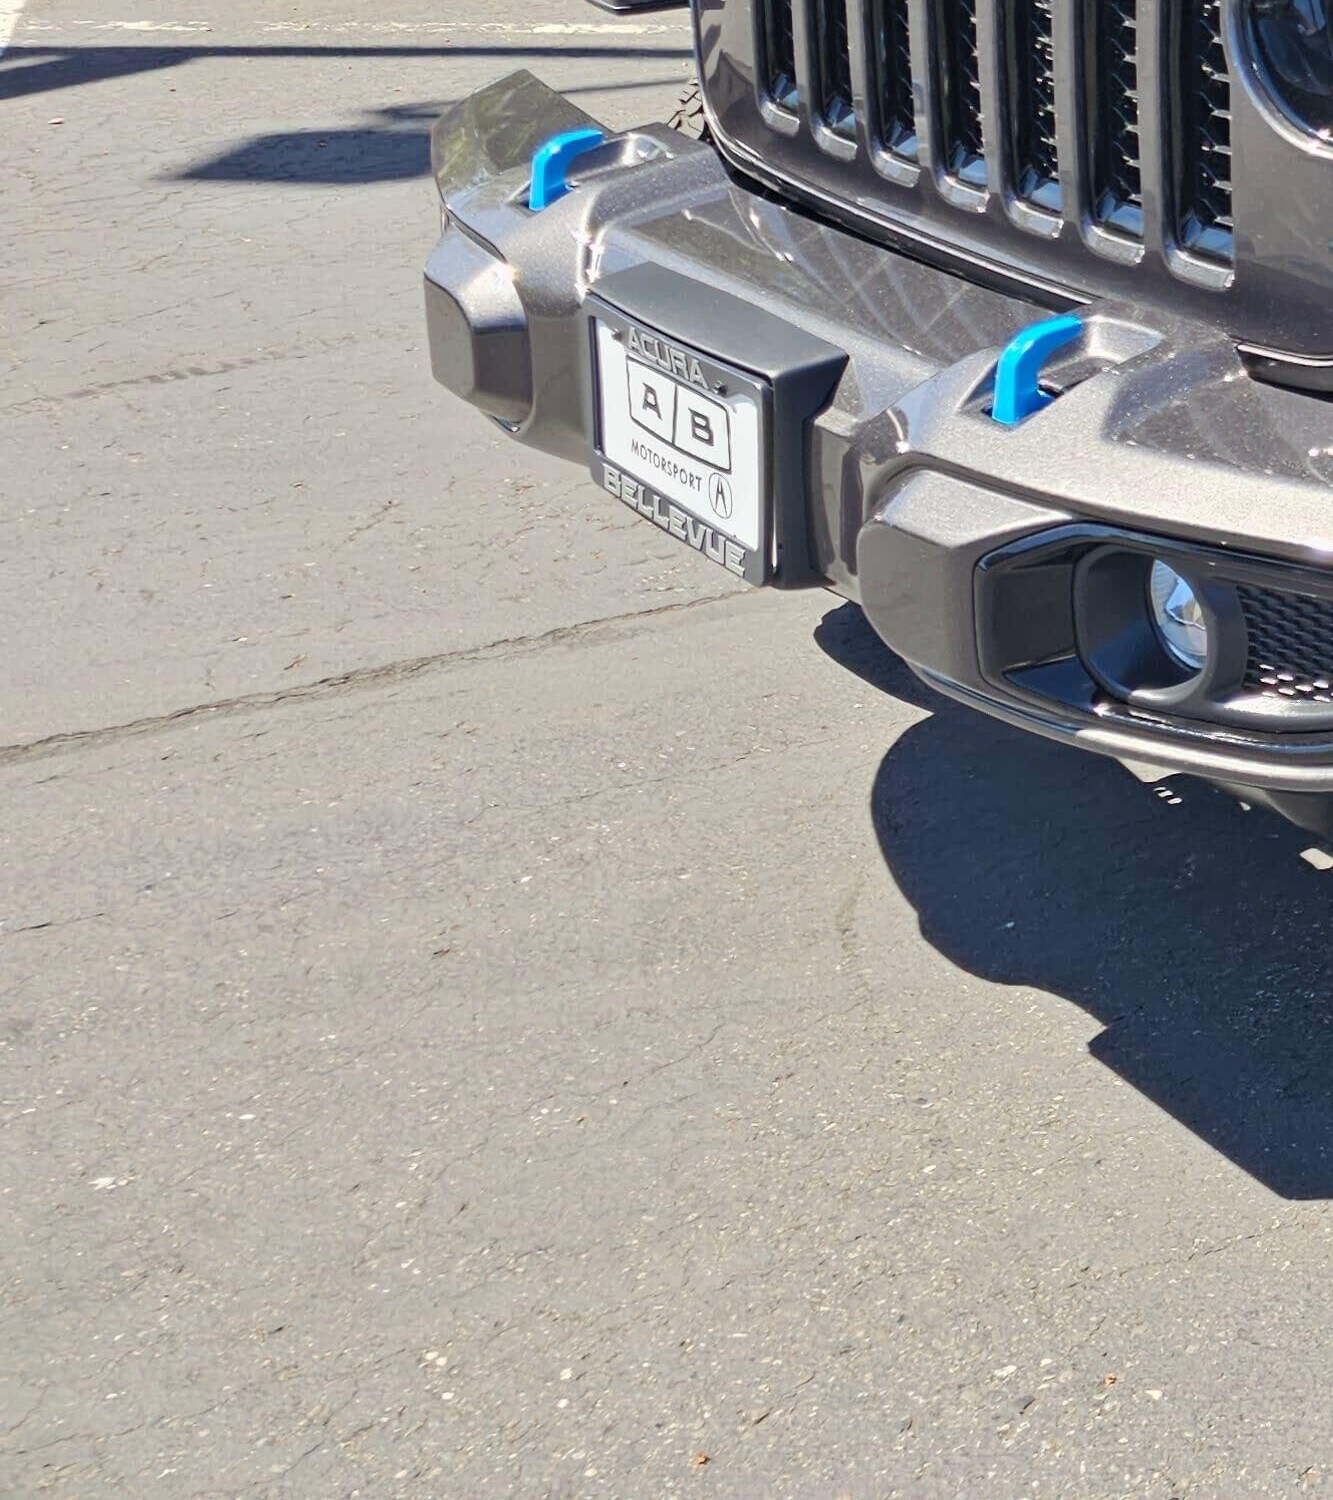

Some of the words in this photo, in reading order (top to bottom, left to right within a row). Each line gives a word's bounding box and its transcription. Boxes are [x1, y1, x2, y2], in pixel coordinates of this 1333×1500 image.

[627, 326, 709, 391] ACURA
[641, 382, 662, 421] A
[688, 407, 714, 446] B
[630, 438, 703, 493] MOTORSPORT
[602, 462, 746, 579] BELLEVUE
